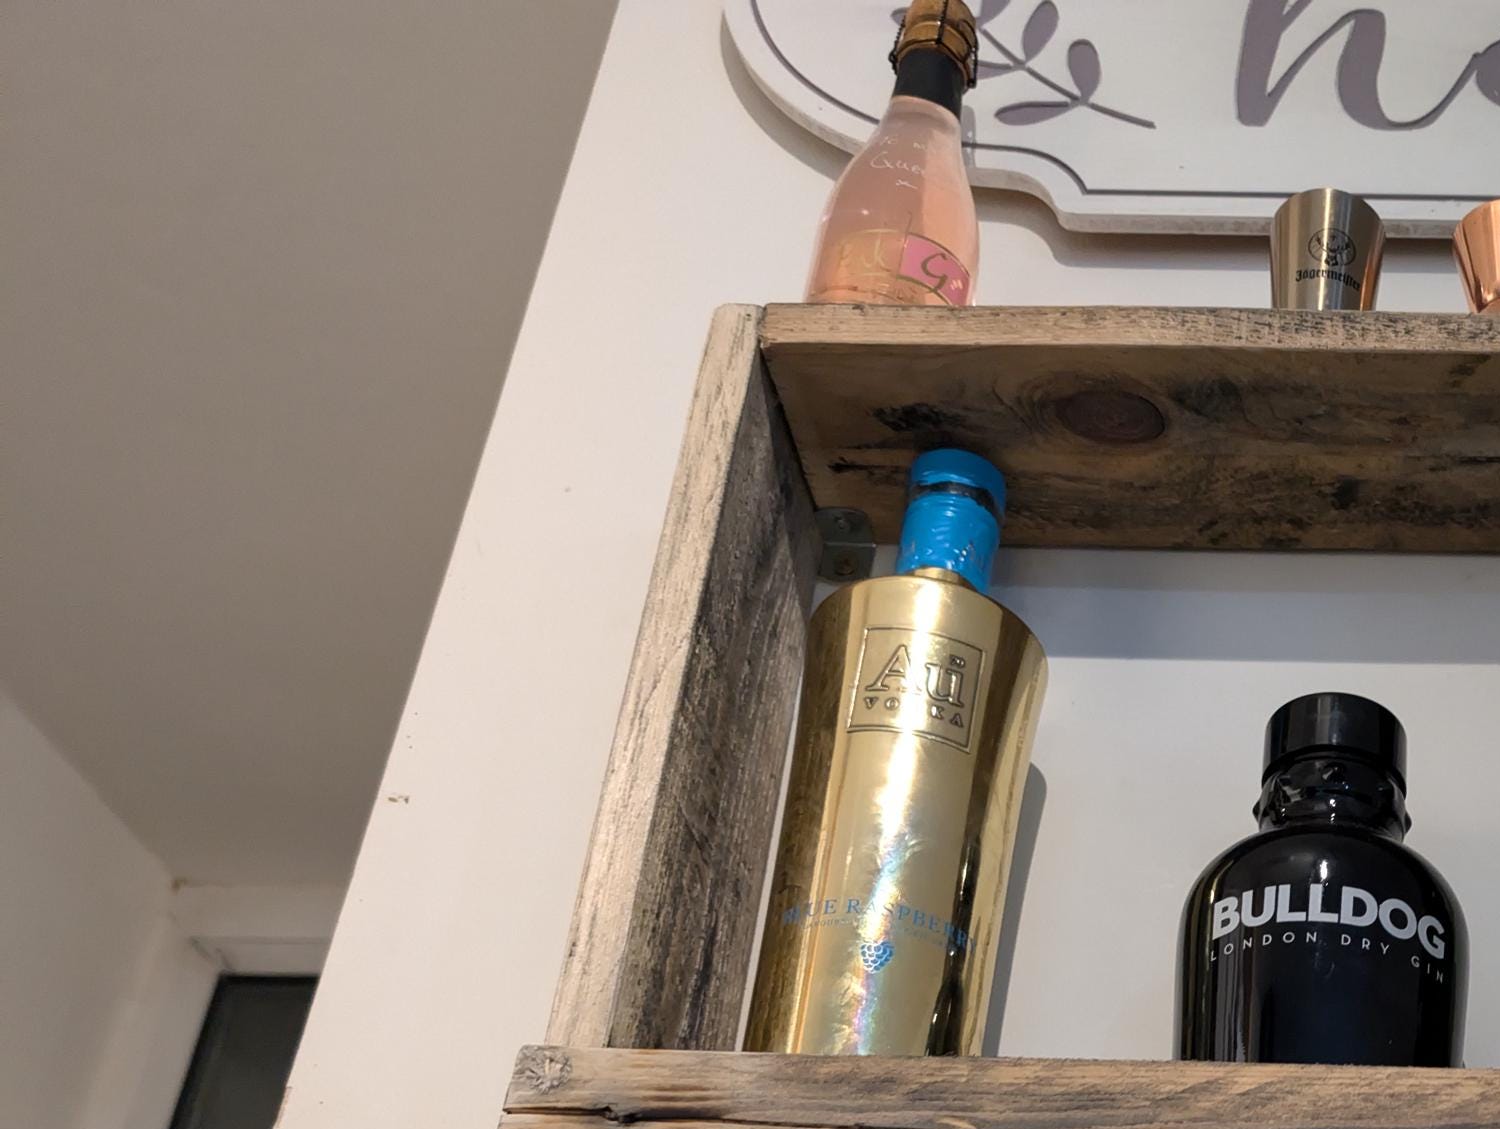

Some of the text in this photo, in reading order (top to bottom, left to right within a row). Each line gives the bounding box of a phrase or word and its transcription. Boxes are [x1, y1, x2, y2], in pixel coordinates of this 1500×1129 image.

[863, 696, 964, 728] VOKA
[1212, 883, 1445, 959] BULLDOG
[1210, 931, 1444, 984] LONDON DRY GIN
